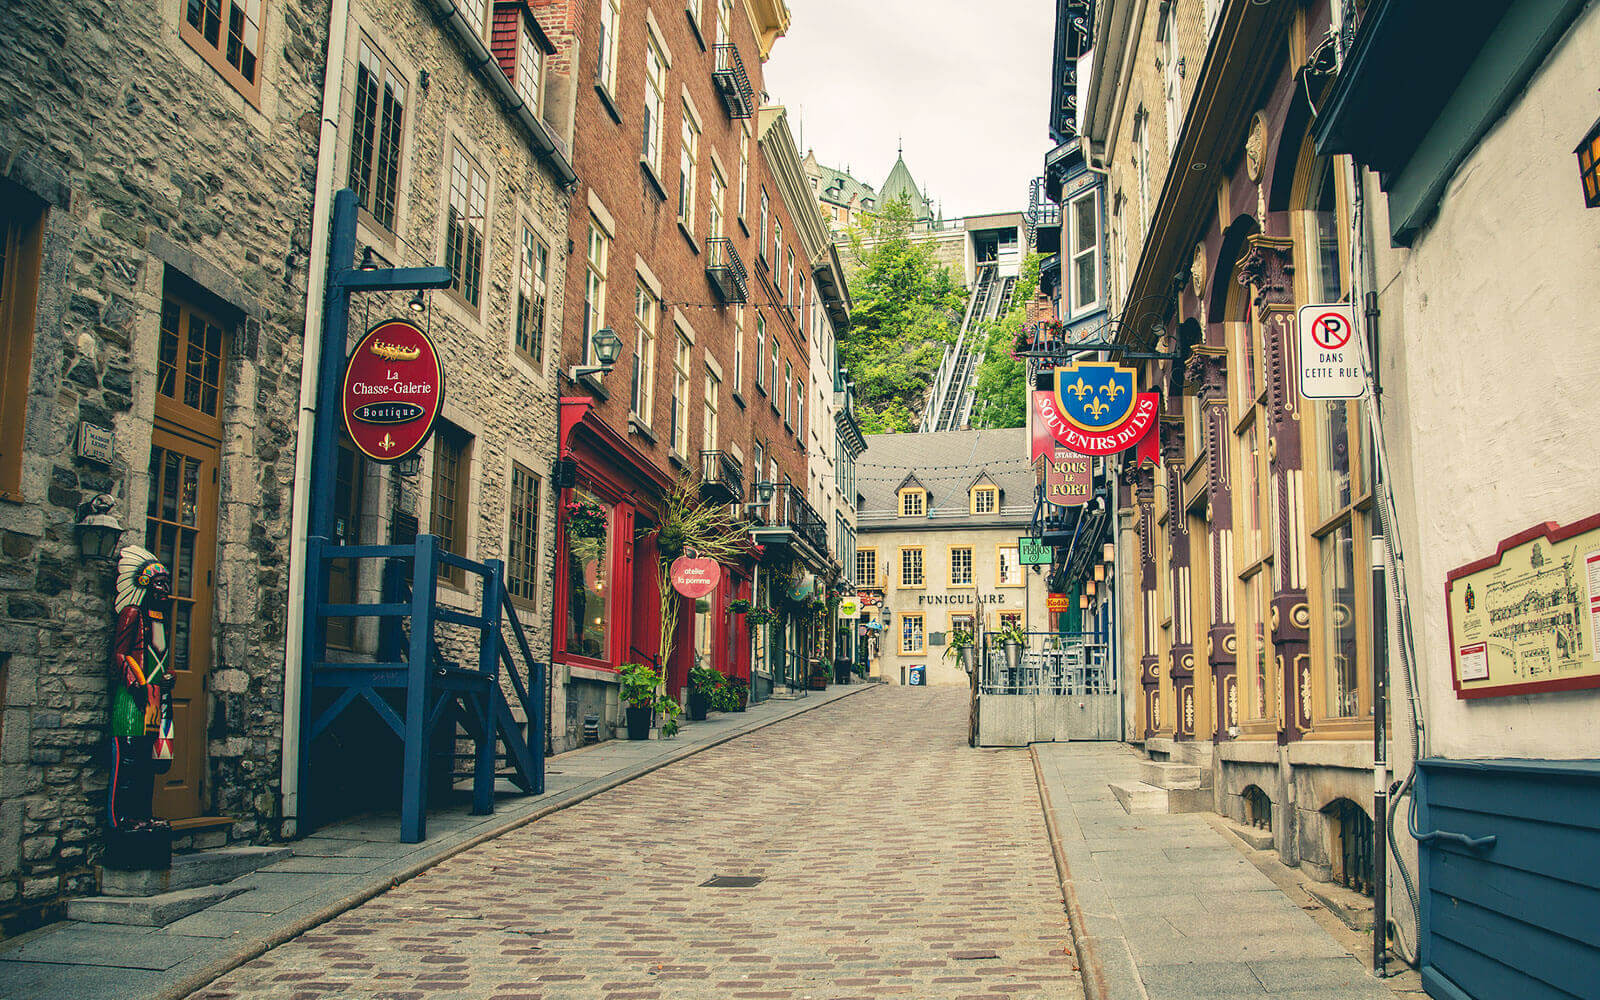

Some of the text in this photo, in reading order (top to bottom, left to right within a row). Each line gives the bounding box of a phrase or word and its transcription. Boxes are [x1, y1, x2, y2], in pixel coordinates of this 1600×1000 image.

[1319, 352, 1344, 363] DANS
[387, 370, 399, 380] La
[1305, 367, 1359, 378] CETTE RUE
[352, 382, 432, 395] Chasse-Galerie
[363, 407, 415, 418] Boutique
[1038, 398, 1154, 450] SOUVENIRS DU LYS
[1053, 462, 1087, 473] SOUS
[1064, 474, 1075, 482] LE
[1052, 484, 1089, 496] FORT
[677, 576, 685, 584] la
[918, 594, 1005, 605] FUNICULAIRE
